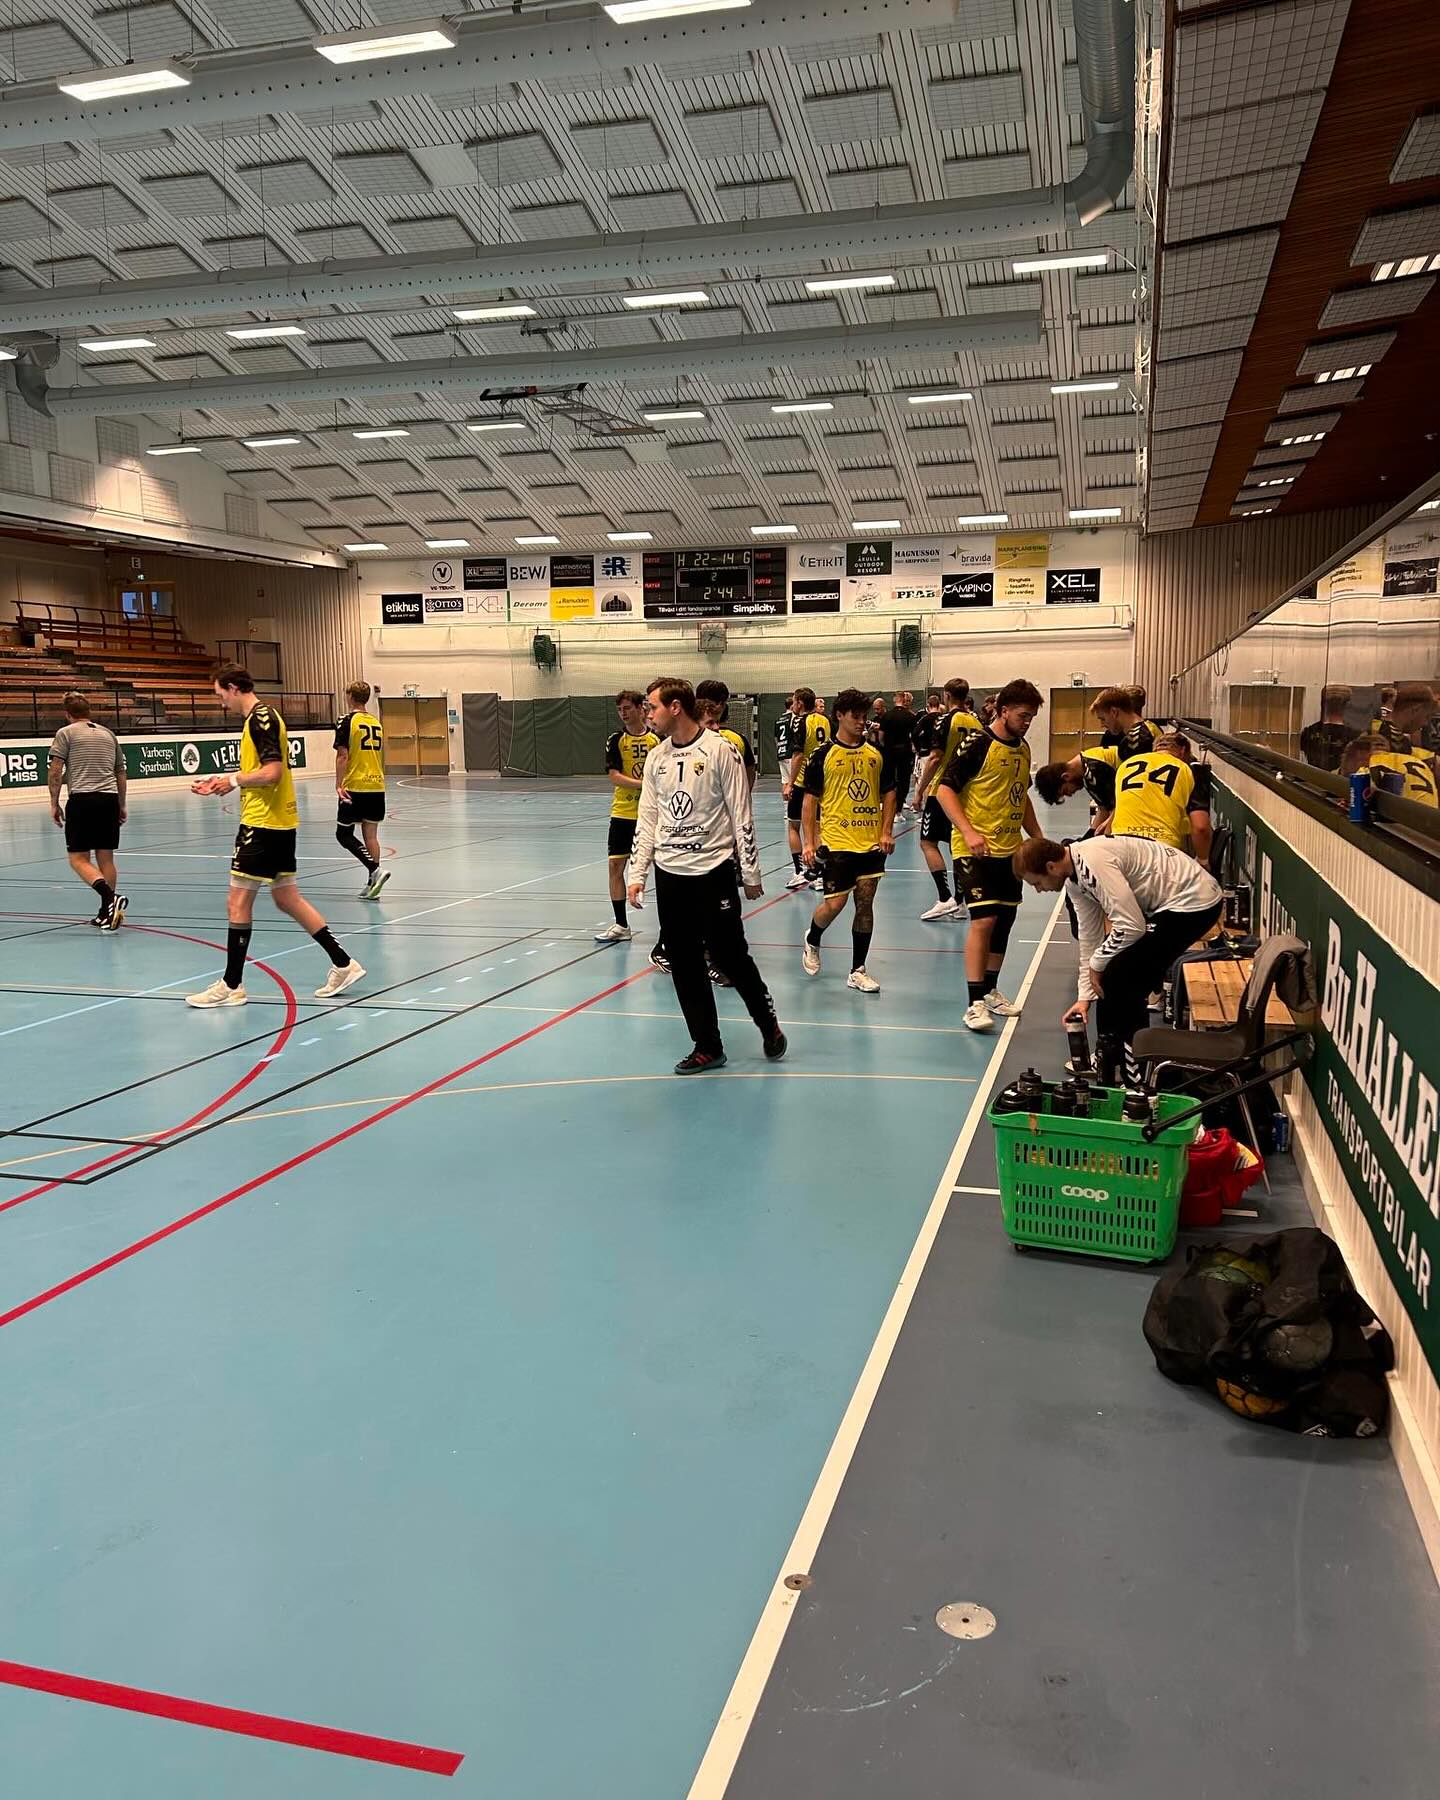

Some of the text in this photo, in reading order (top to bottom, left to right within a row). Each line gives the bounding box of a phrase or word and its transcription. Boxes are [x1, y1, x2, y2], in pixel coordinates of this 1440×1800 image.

[677, 554, 685, 566] H
[743, 551, 751, 564] G
[894, 549, 940, 558] MAGNUSSON
[961, 553, 992, 563] bravida
[711, 572, 718, 581] 2
[1051, 573, 1096, 589] XEL
[897, 590, 936, 599] PEAB
[943, 583, 992, 594] CAMPINO
[385, 602, 420, 613] etikhus
[434, 600, 462, 608] OTTO'S
[358, 724, 383, 751] 25
[779, 725, 786, 741] 2
[141, 747, 175, 760] Varbergs
[631, 744, 648, 759] 35
[139, 760, 175, 775] Sparbank
[677, 761, 684, 782] 1
[850, 759, 864, 775] 13
[1013, 758, 1021, 778] 7
[9, 771, 38, 783] HISS
[1121, 760, 1181, 798] 24
[852, 806, 878, 815] coop
[671, 843, 702, 851] coop
[1061, 1184, 1109, 1202] coop
[1328, 1069, 1431, 1311] TRANSPORTBILAR
